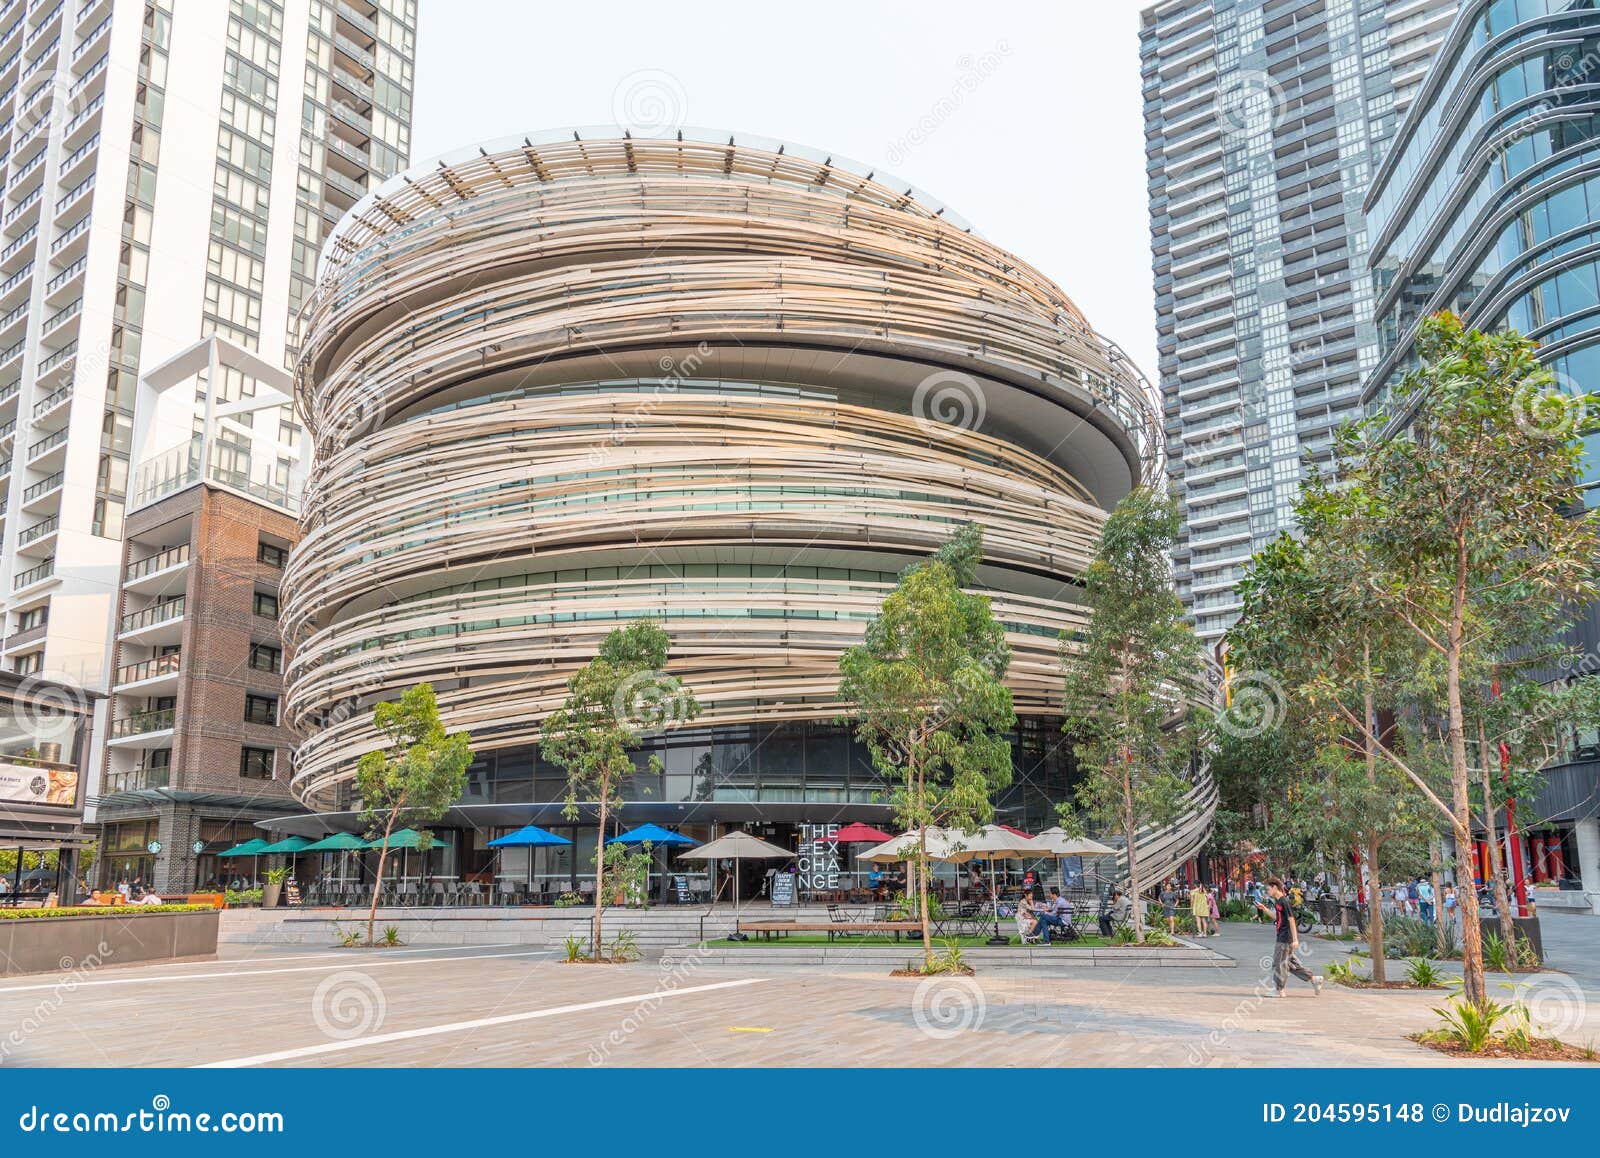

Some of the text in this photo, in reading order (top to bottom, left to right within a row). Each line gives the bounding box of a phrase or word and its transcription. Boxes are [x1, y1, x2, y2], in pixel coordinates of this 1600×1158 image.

[798, 824, 839, 838] THE
[813, 841, 839, 855] EX
[798, 857, 840, 872] CHA
[798, 874, 839, 889] NGE
